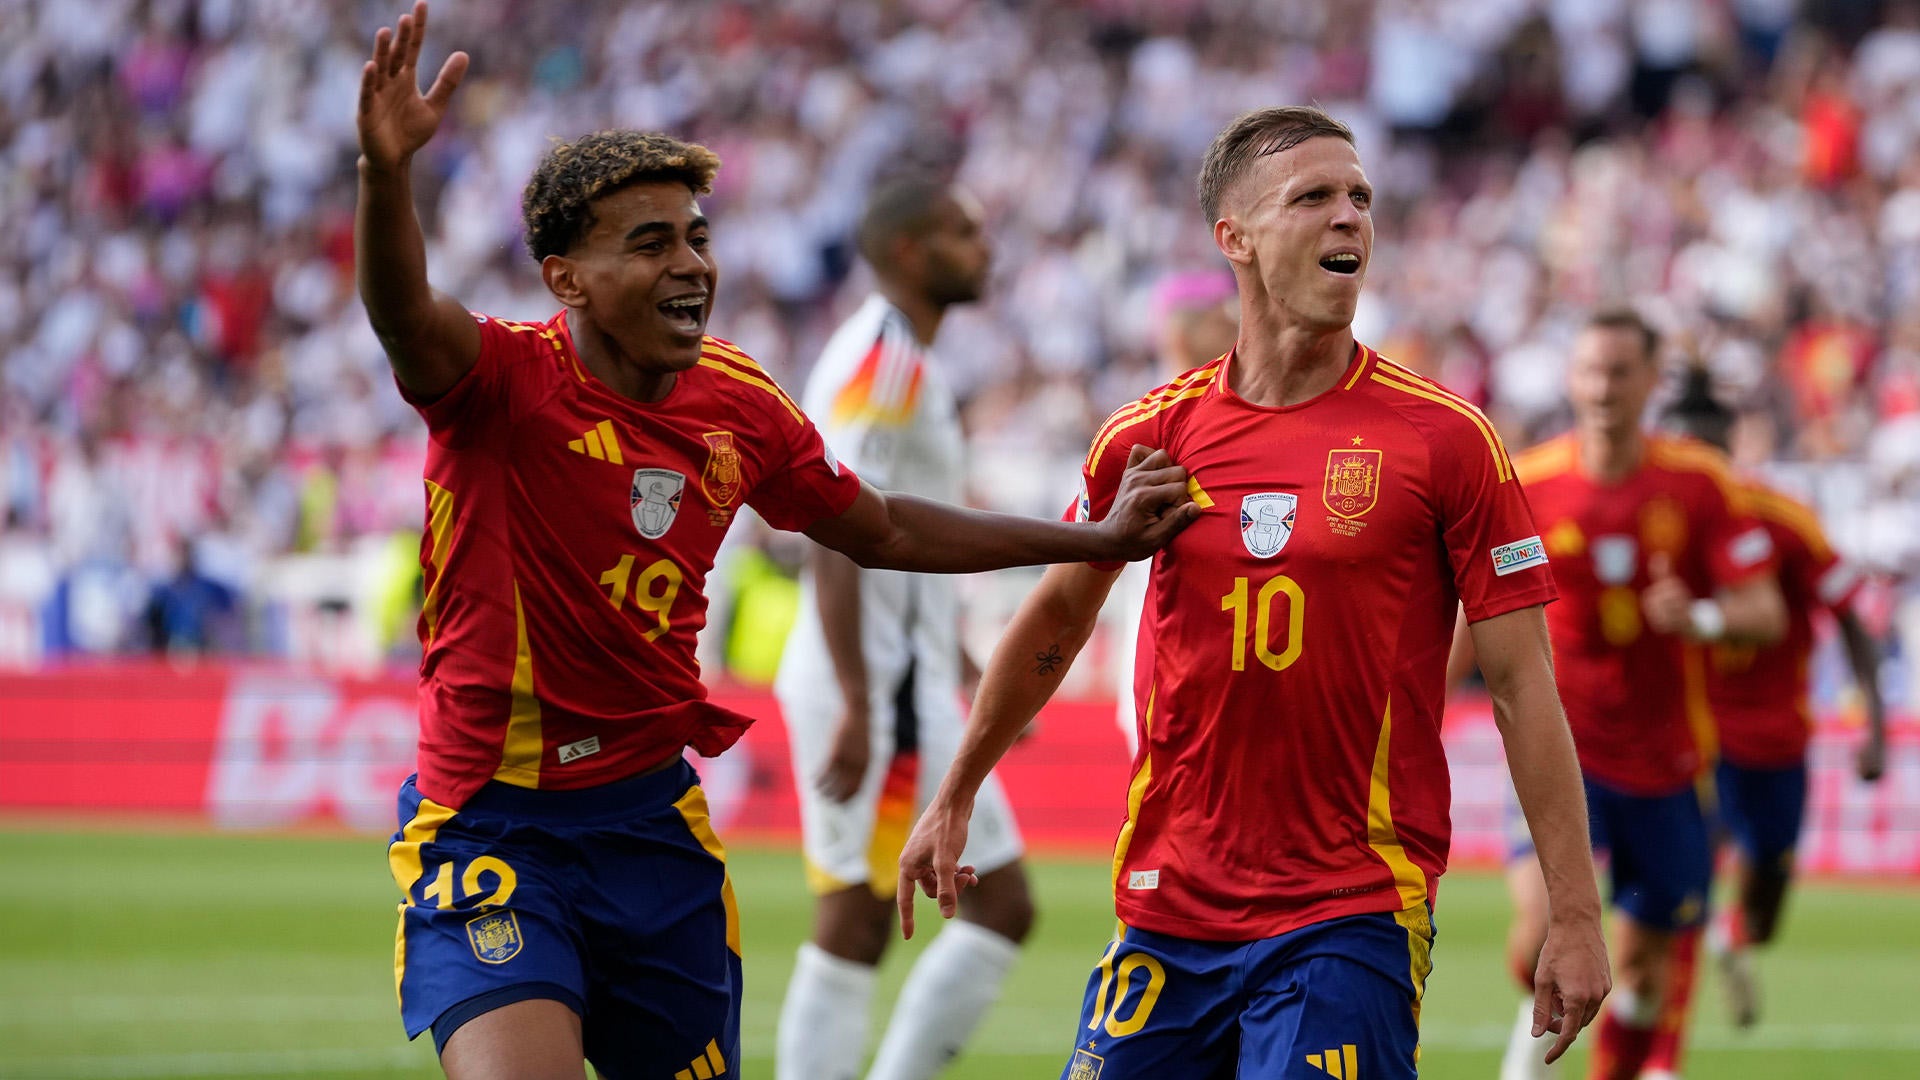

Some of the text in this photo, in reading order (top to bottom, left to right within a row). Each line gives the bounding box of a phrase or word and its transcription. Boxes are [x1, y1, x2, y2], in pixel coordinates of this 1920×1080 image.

[1493, 546, 1511, 556] UEFA
[599, 554, 683, 643] 19
[1222, 575, 1305, 671] 10
[1088, 941, 1166, 1038] 10
